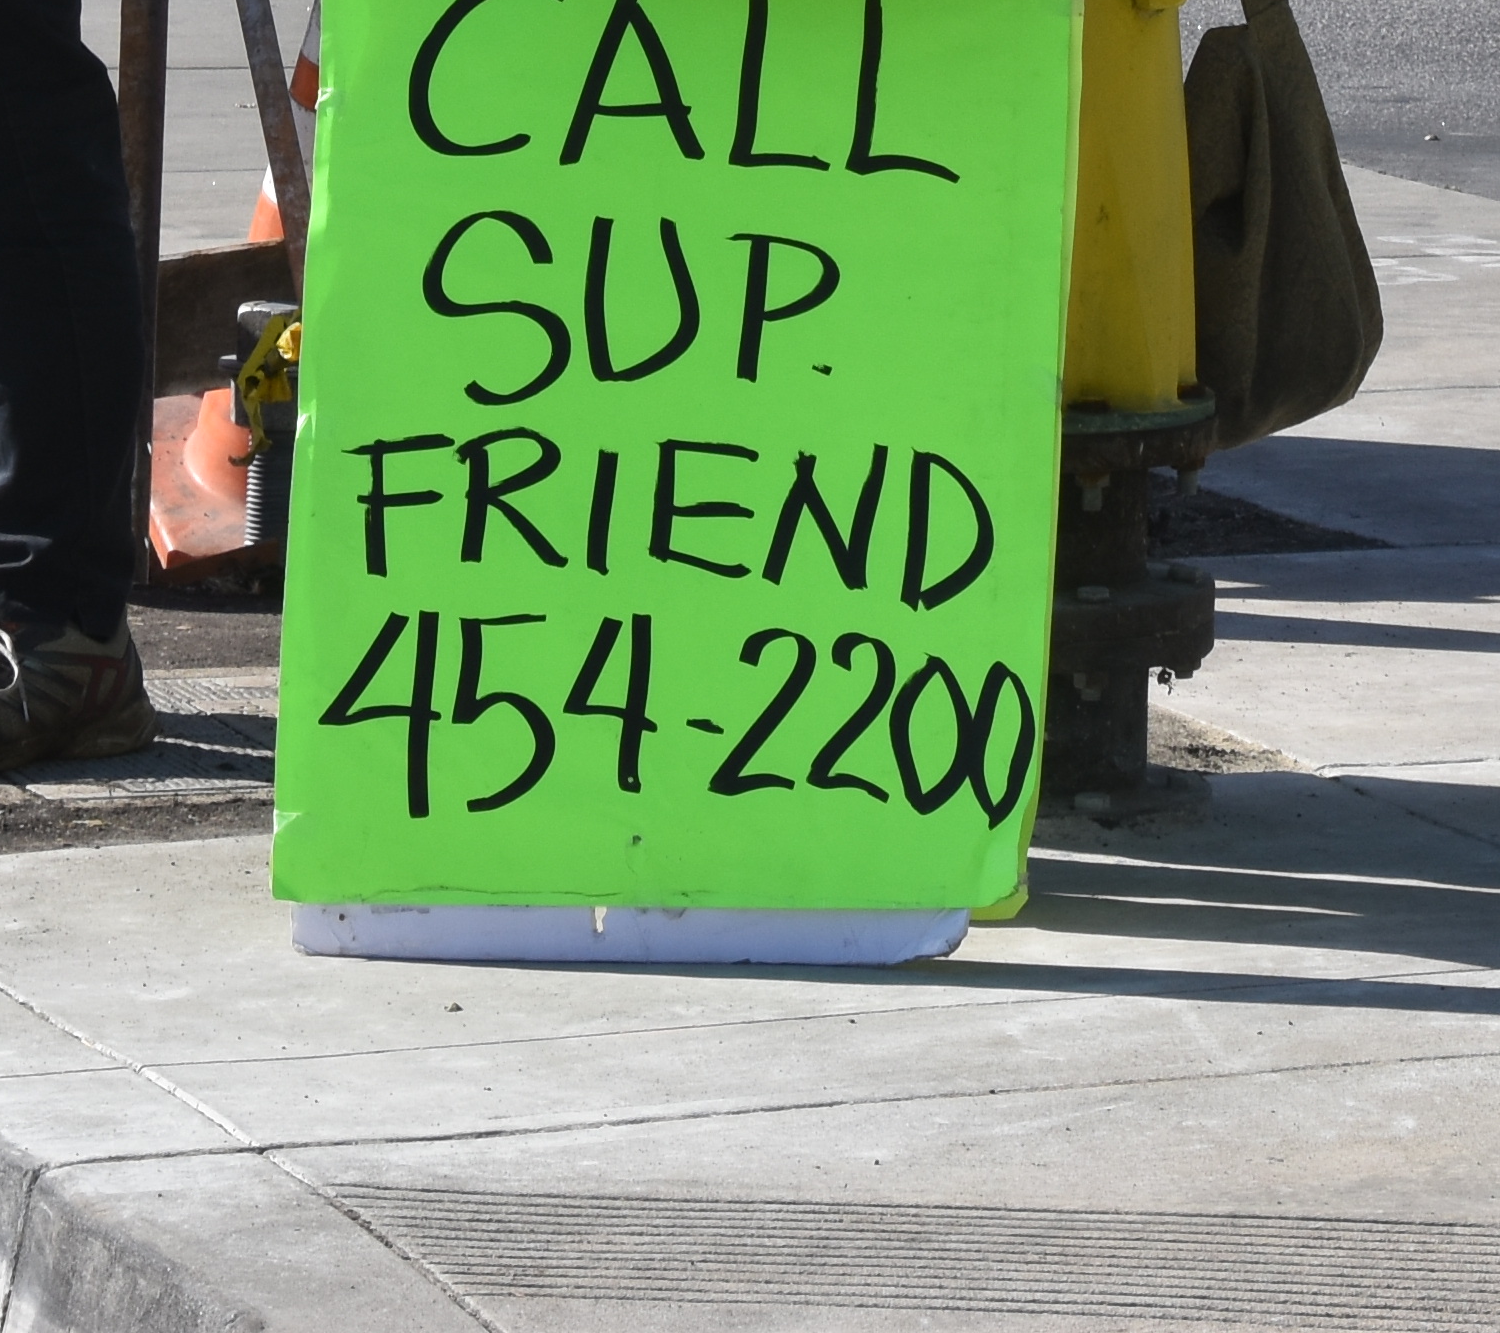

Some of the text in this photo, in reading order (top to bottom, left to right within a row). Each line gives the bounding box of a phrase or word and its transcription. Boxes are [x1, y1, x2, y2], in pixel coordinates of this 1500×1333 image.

[421, 209, 842, 405] SUP.
[341, 426, 995, 612] FRIEND
[318, 610, 1037, 829] 454-2200
